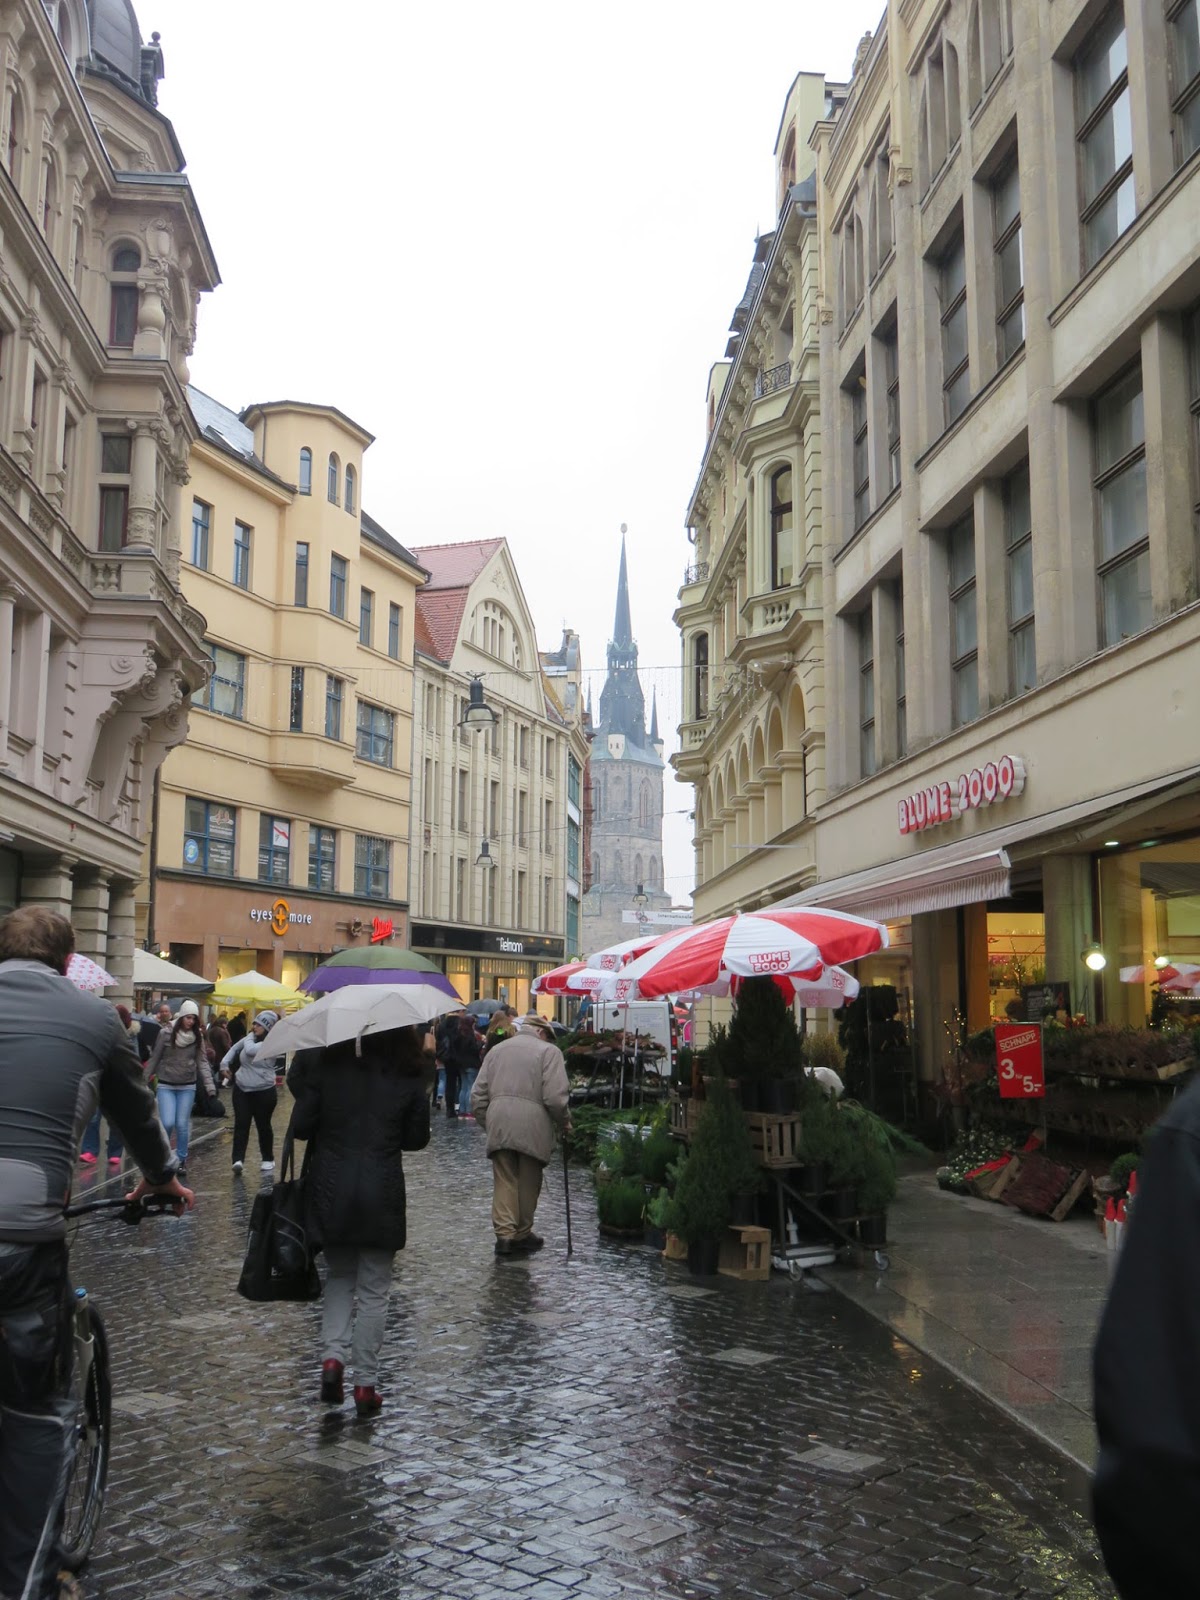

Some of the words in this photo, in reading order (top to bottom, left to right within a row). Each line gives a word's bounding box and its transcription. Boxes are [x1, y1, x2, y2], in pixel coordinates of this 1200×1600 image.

[898, 782, 952, 835] BLUME
[958, 755, 1016, 811] 2000
[250, 908, 273, 922] eyes
[289, 911, 312, 924] more
[749, 950, 791, 963] BLUME
[753, 961, 788, 973] 2000
[999, 1032, 1036, 1051] SCHNAPP
[1001, 1058, 1015, 1080] 3
